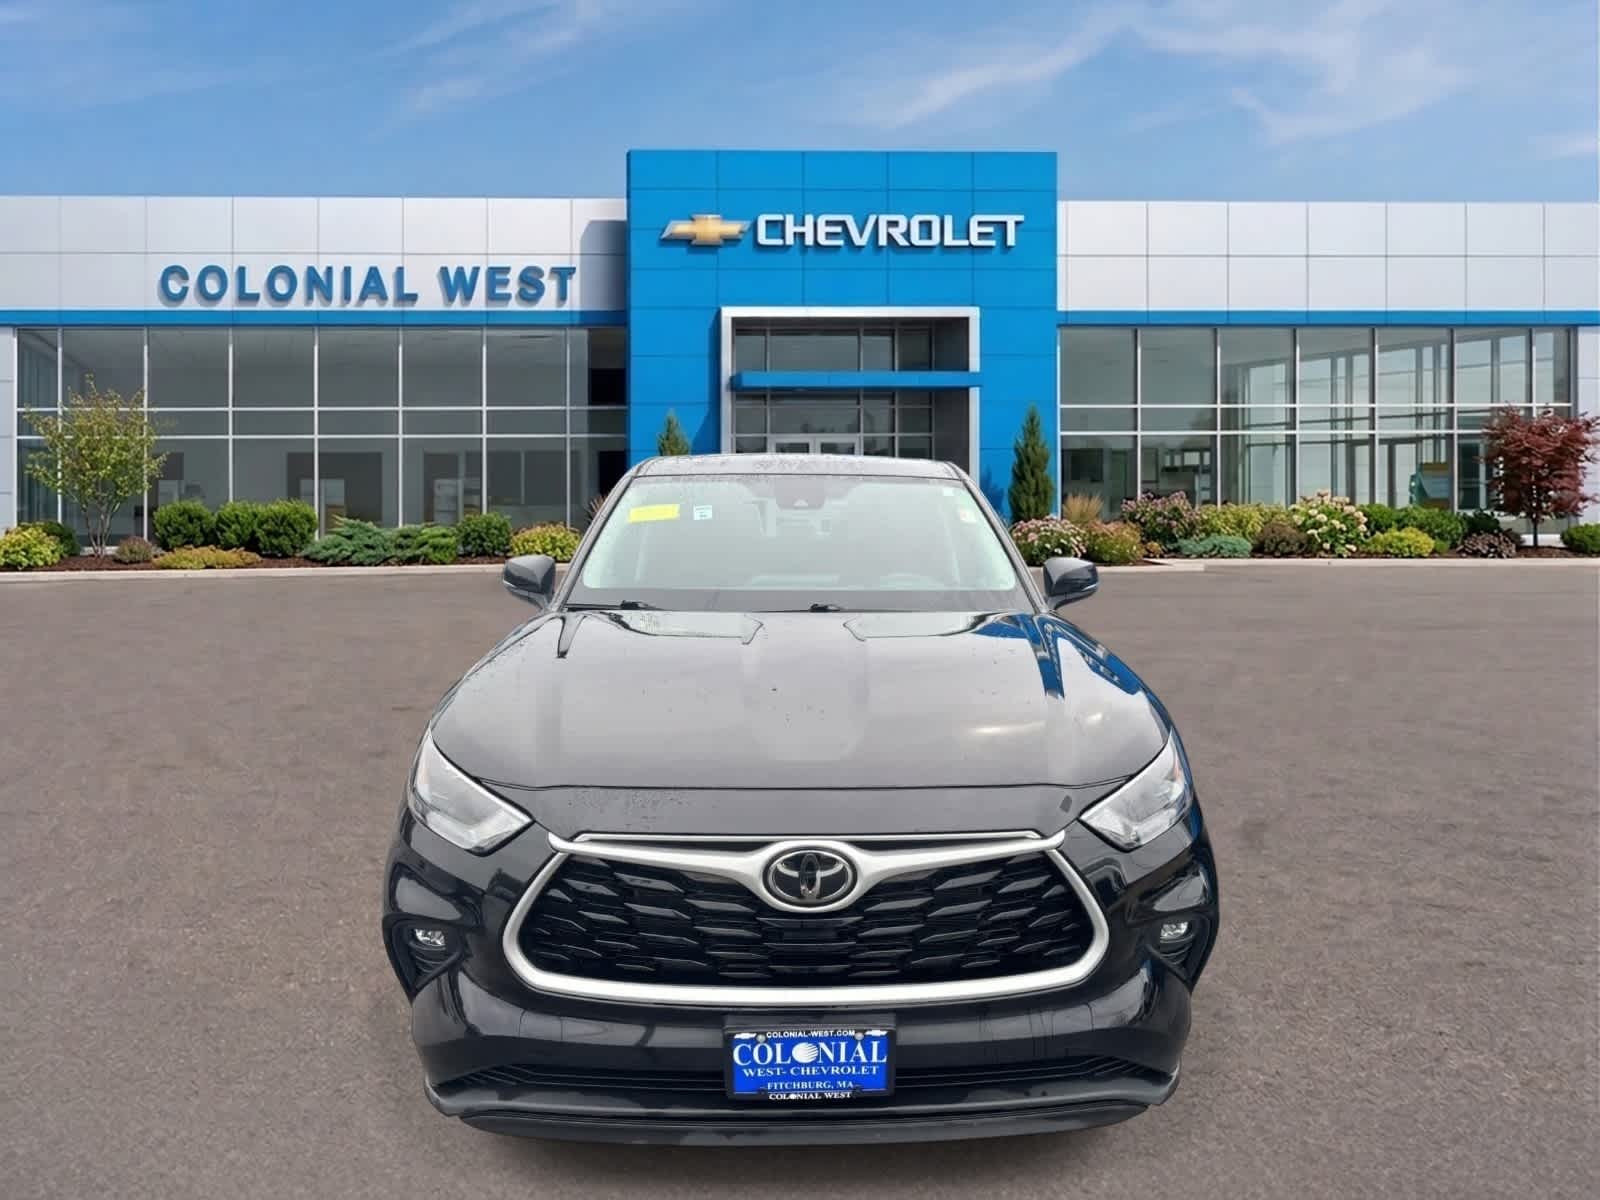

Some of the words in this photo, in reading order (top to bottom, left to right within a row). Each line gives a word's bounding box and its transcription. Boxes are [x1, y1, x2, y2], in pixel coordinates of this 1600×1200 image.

[756, 213, 1024, 248] CHEVROLET
[159, 264, 418, 305] COLONIAL
[440, 265, 577, 304] WEST
[766, 1030, 856, 1039] COLONIAL-WEST.COM
[790, 1065, 880, 1076] CHEVROLET
[837, 1080, 854, 1088] MA
[824, 1091, 852, 1099] WEST
